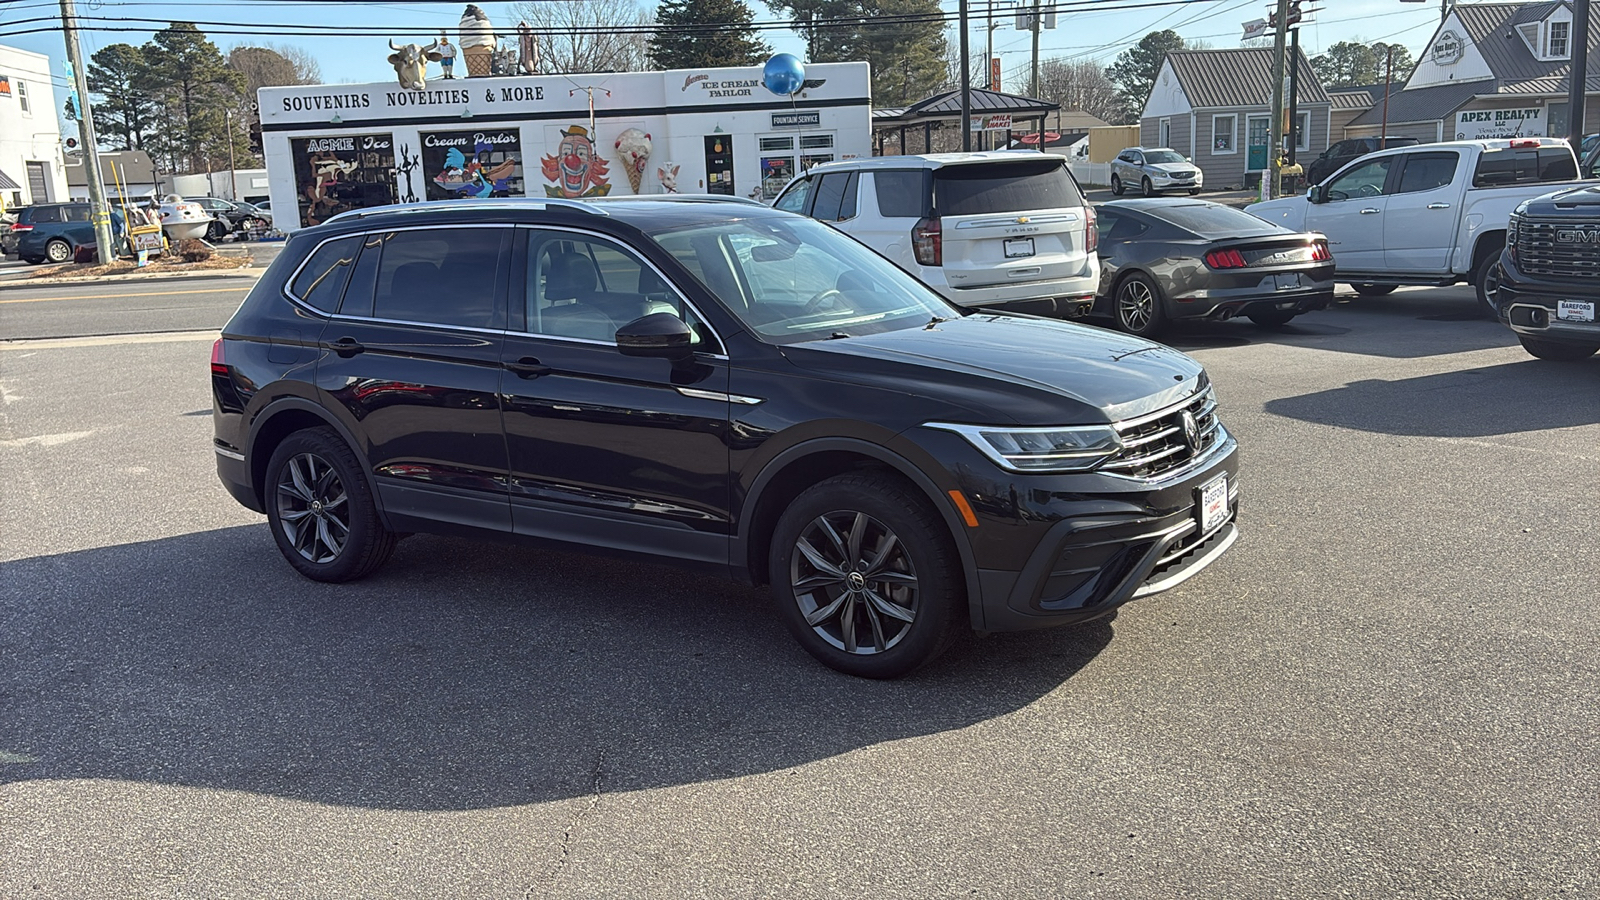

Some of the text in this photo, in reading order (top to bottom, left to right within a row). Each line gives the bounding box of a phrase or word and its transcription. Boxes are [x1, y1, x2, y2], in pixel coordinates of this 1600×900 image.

[702, 79, 759, 90] ICE CREAM
[283, 86, 544, 112] SOUVENIRS NOVELTIES & MORE
[709, 89, 752, 98] PARLOR
[773, 113, 819, 125] FOUNTAIN SERVICE
[992, 114, 1012, 122] MILK
[1461, 109, 1540, 123] APEX REALTY
[307, 136, 391, 152] ACME Ice
[424, 131, 518, 148] Cream Parlor
[1561, 303, 1591, 311] BAREFORD
[1204, 484, 1225, 507] BAREFORD
[1209, 500, 1221, 514] GMC
